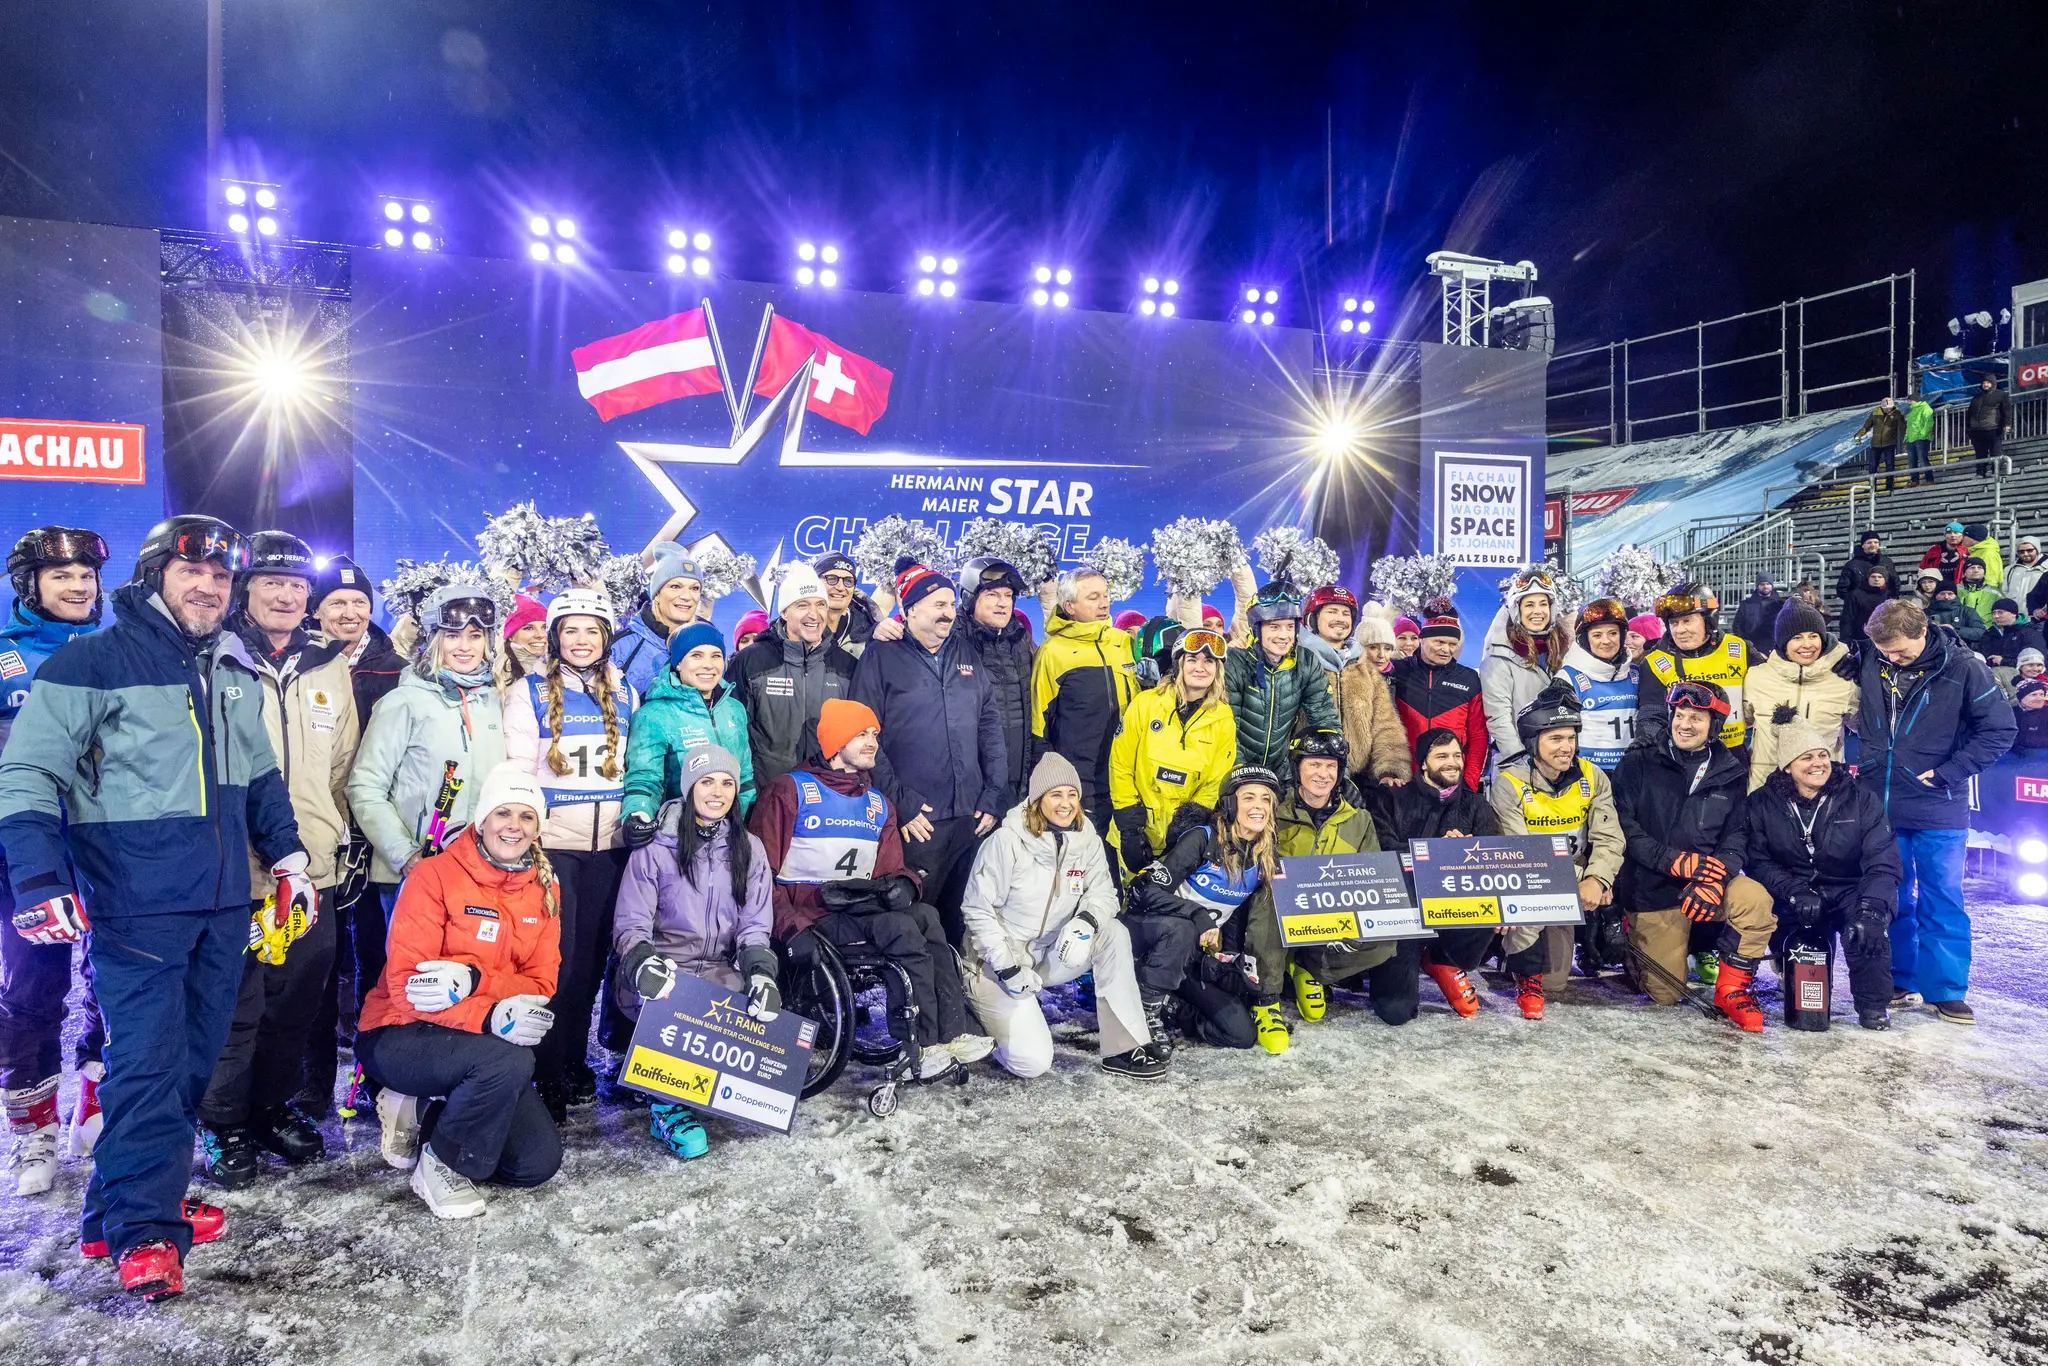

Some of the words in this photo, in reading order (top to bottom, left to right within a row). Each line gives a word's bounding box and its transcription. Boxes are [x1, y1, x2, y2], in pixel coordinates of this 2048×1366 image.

[891, 474, 983, 492] HERMANN
[1451, 471, 1516, 484] FLACHAU
[985, 478, 1094, 517] STAR
[1450, 483, 1516, 504] SNOW
[922, 498, 979, 513] MAIER
[1451, 504, 1516, 517] WAGRAIN
[1450, 517, 1515, 537] SPACE
[1450, 537, 1465, 549] ST.
[1467, 538, 1515, 549] JOHANN
[1449, 553, 1516, 564] SALZBURG
[1608, 716, 1634, 740] 11
[835, 848, 858, 876] 4
[1482, 852, 1493, 860] 3.
[1494, 851, 1524, 860] RANG
[1337, 870, 1347, 878] 2.
[1348, 867, 1377, 877] RANG
[1442, 875, 1456, 892] €
[1461, 873, 1522, 892] 5.000
[1295, 893, 1309, 909] €
[1312, 889, 1380, 908] 10.000
[1428, 909, 1479, 920] Raiffeisen
[1521, 904, 1574, 913] Doppelmayr
[1288, 925, 1338, 937] Raiffeisen
[1377, 919, 1420, 927] Doppelma
[673, 1011, 703, 1026] HERMANN
[704, 1022, 722, 1033] MAIER
[722, 1028, 738, 1038] STAR
[737, 1033, 771, 1050] CHALLENGE
[726, 1013, 732, 1024] 1.
[735, 1016, 766, 1036] RANG
[660, 1024, 678, 1047] €
[682, 1030, 755, 1072] 15.000
[632, 1063, 690, 1091] Raiffeisen
[757, 1070, 772, 1080] EURO
[759, 1064, 782, 1076] TAUSEND
[735, 1092, 788, 1115] Doppelmayr
